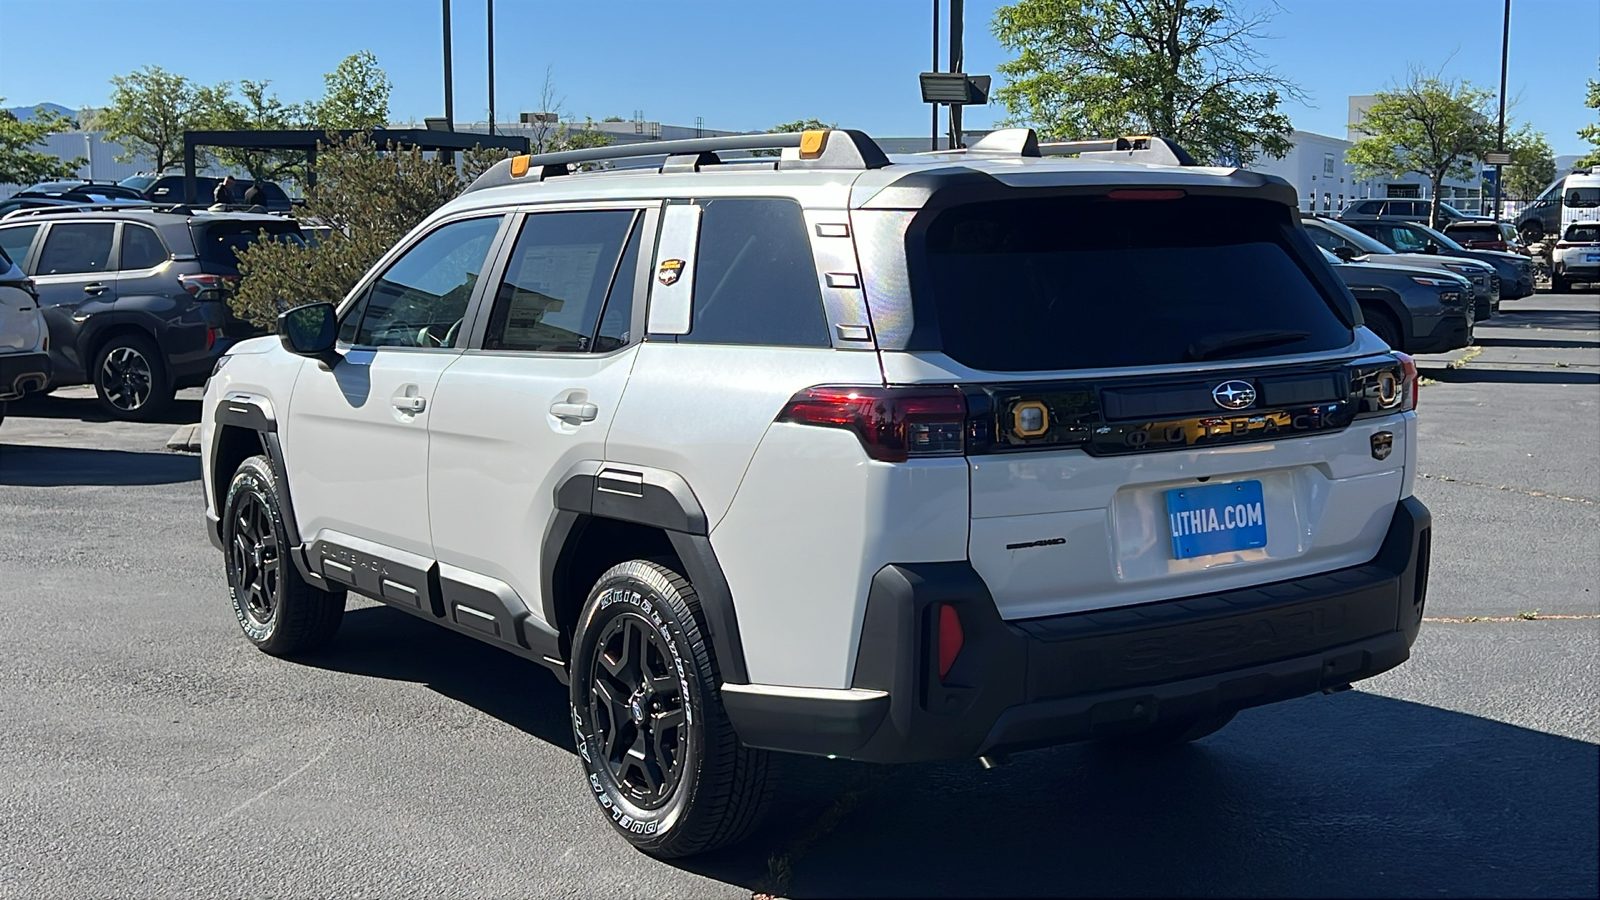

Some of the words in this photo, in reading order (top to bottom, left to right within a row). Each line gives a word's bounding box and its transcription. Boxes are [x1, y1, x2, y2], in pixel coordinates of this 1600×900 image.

[1125, 412, 1335, 448] OUTBACK
[1170, 502, 1263, 537] LITHIA.COM
[589, 771, 659, 835] DUELER
